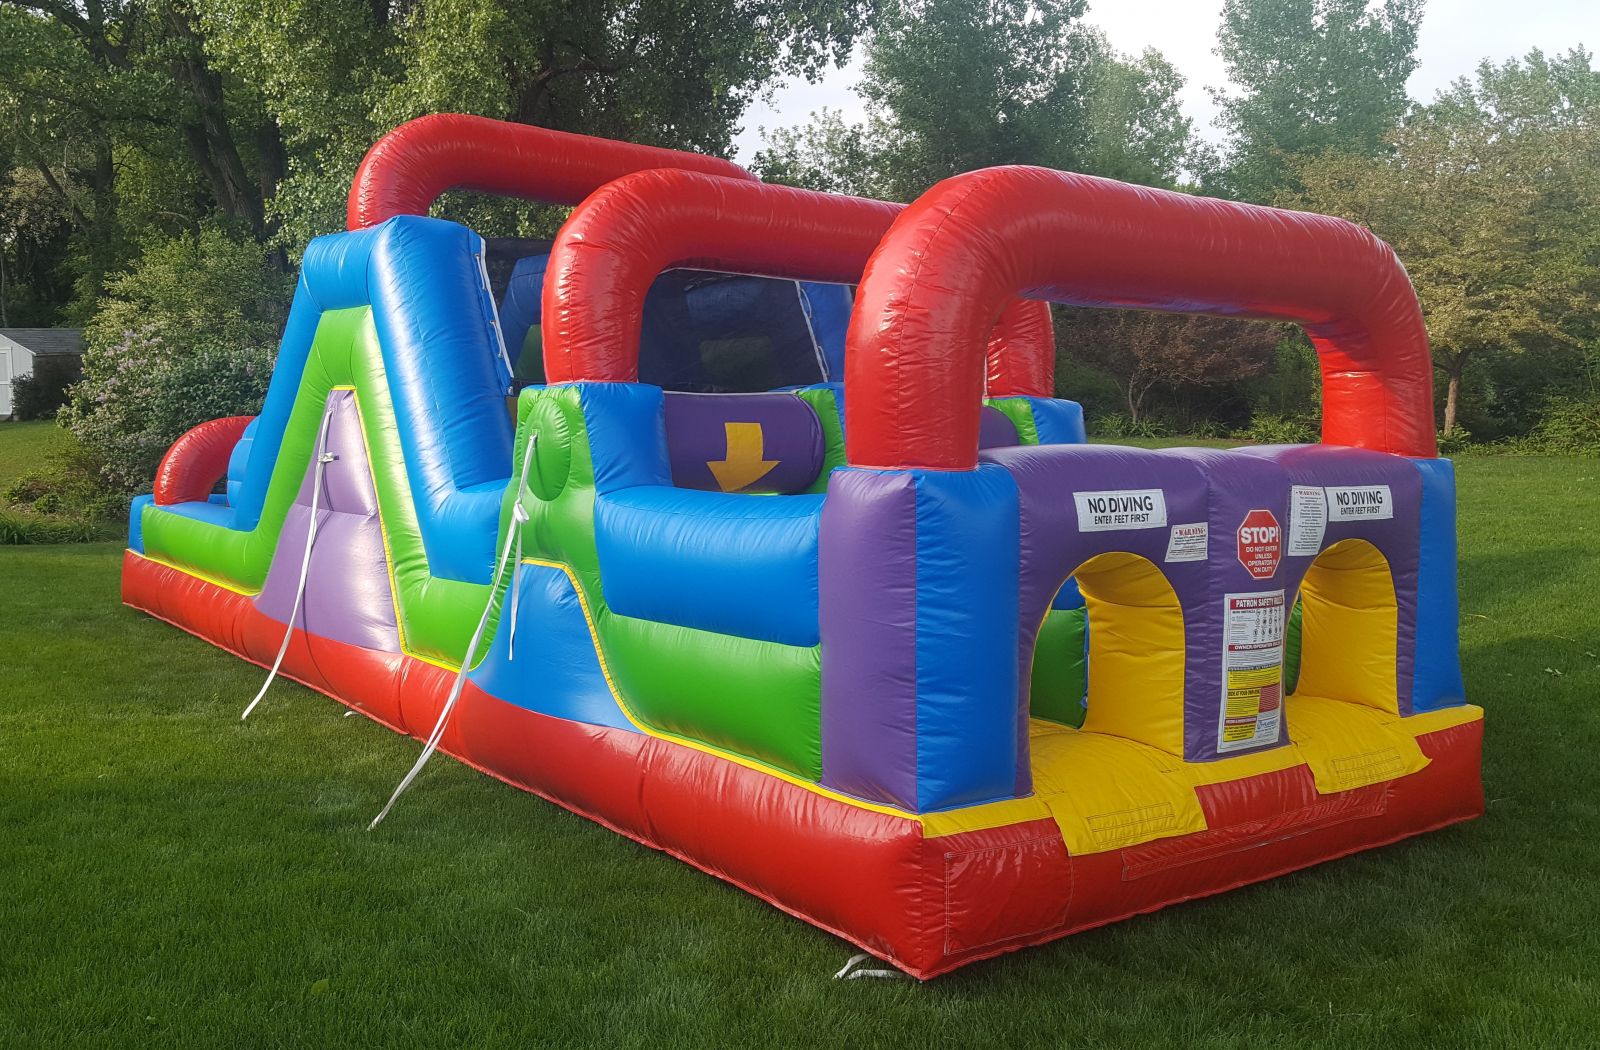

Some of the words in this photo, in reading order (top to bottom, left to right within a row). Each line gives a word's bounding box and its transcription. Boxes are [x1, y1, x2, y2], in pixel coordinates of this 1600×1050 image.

[1336, 491, 1350, 505] NO
[1352, 491, 1383, 504] DIVING
[1088, 498, 1106, 513] NO
[1109, 496, 1153, 512] DIVING
[1340, 507, 1354, 515] ENTER
[1355, 506, 1366, 514] FEET
[1366, 506, 1380, 514] FIRST
[1094, 515, 1112, 524] ENTER
[1114, 514, 1129, 524] FEET
[1131, 513, 1149, 522] FIRST
[1240, 526, 1279, 544] STOP!
[1236, 599, 1257, 608] PATRON
[1258, 598, 1274, 607] SAFETY
